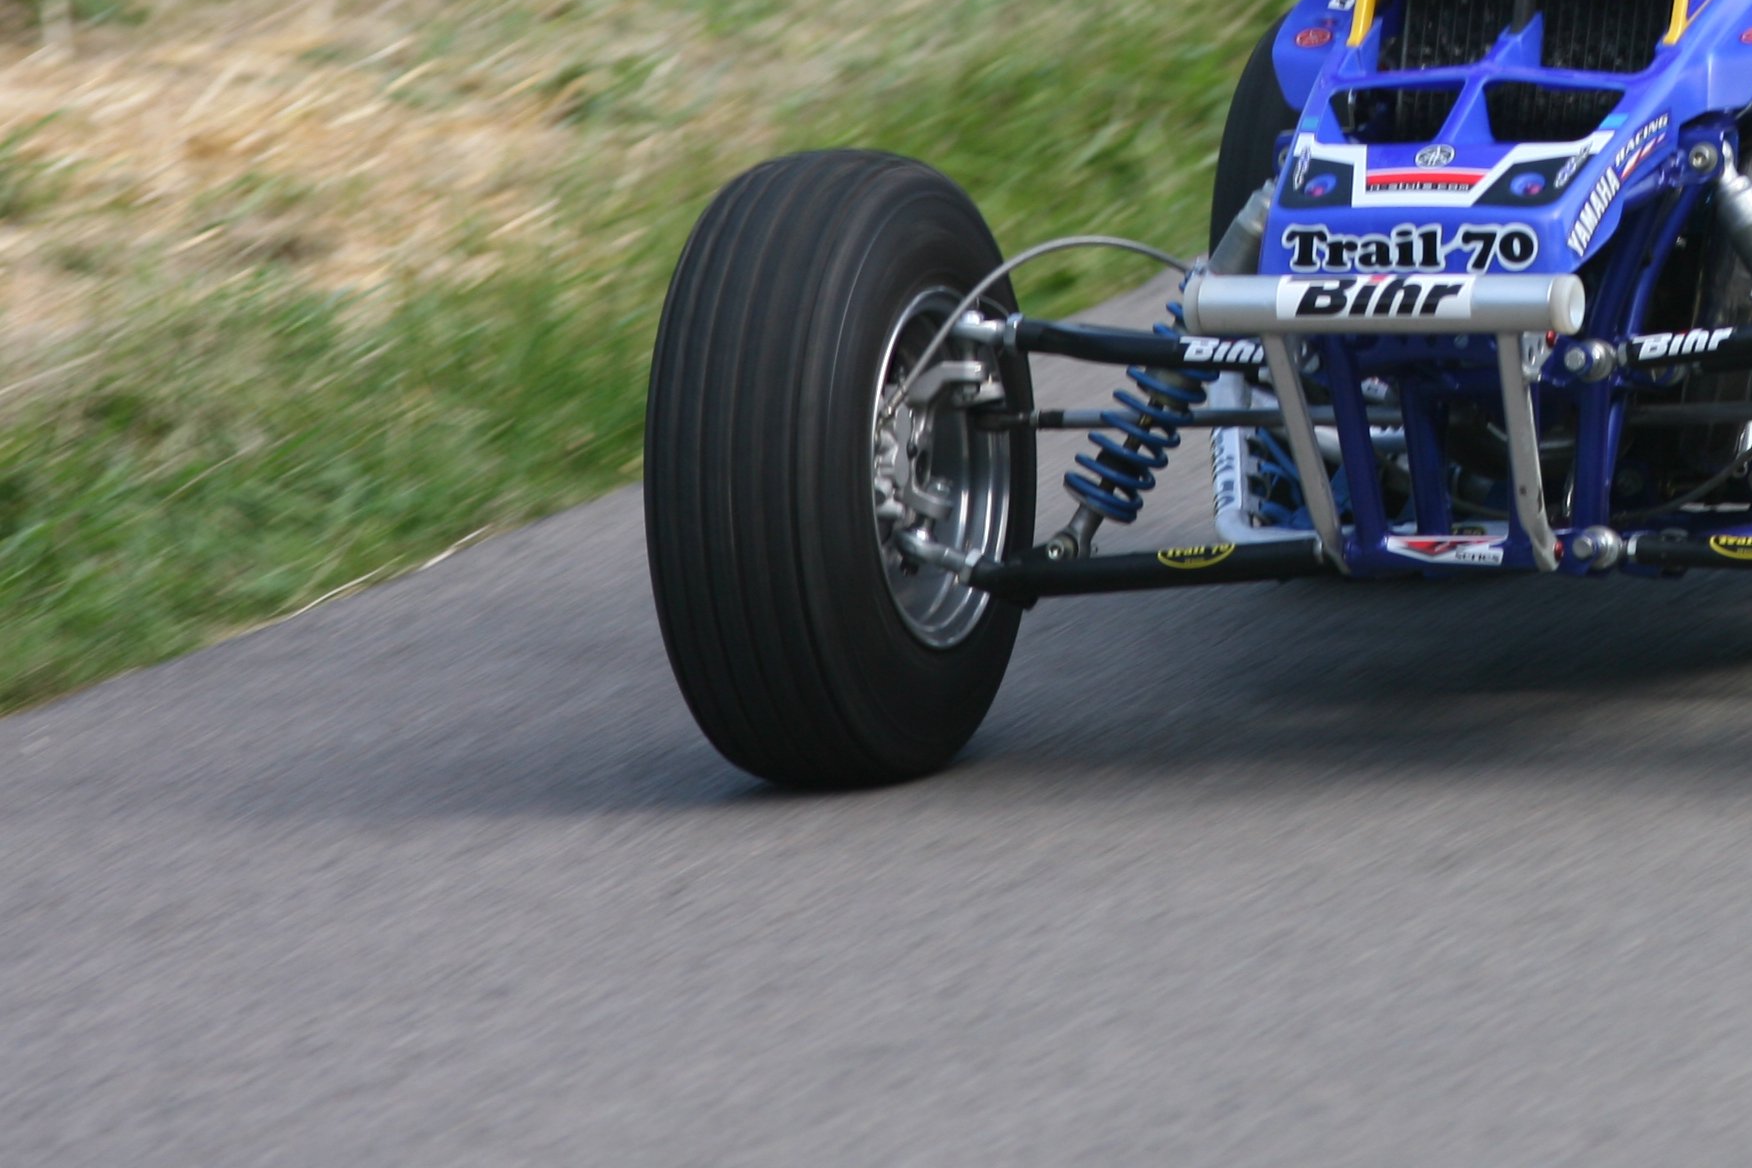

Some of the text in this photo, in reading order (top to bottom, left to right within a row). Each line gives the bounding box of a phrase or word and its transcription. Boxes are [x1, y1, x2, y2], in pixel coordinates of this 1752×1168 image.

[1567, 166, 1621, 257] YAMAHA
[1615, 113, 1669, 167] RACING
[1283, 226, 1537, 271] Trail 70
[1291, 275, 1467, 318] Bihr
[1632, 326, 1734, 361] Bihr
